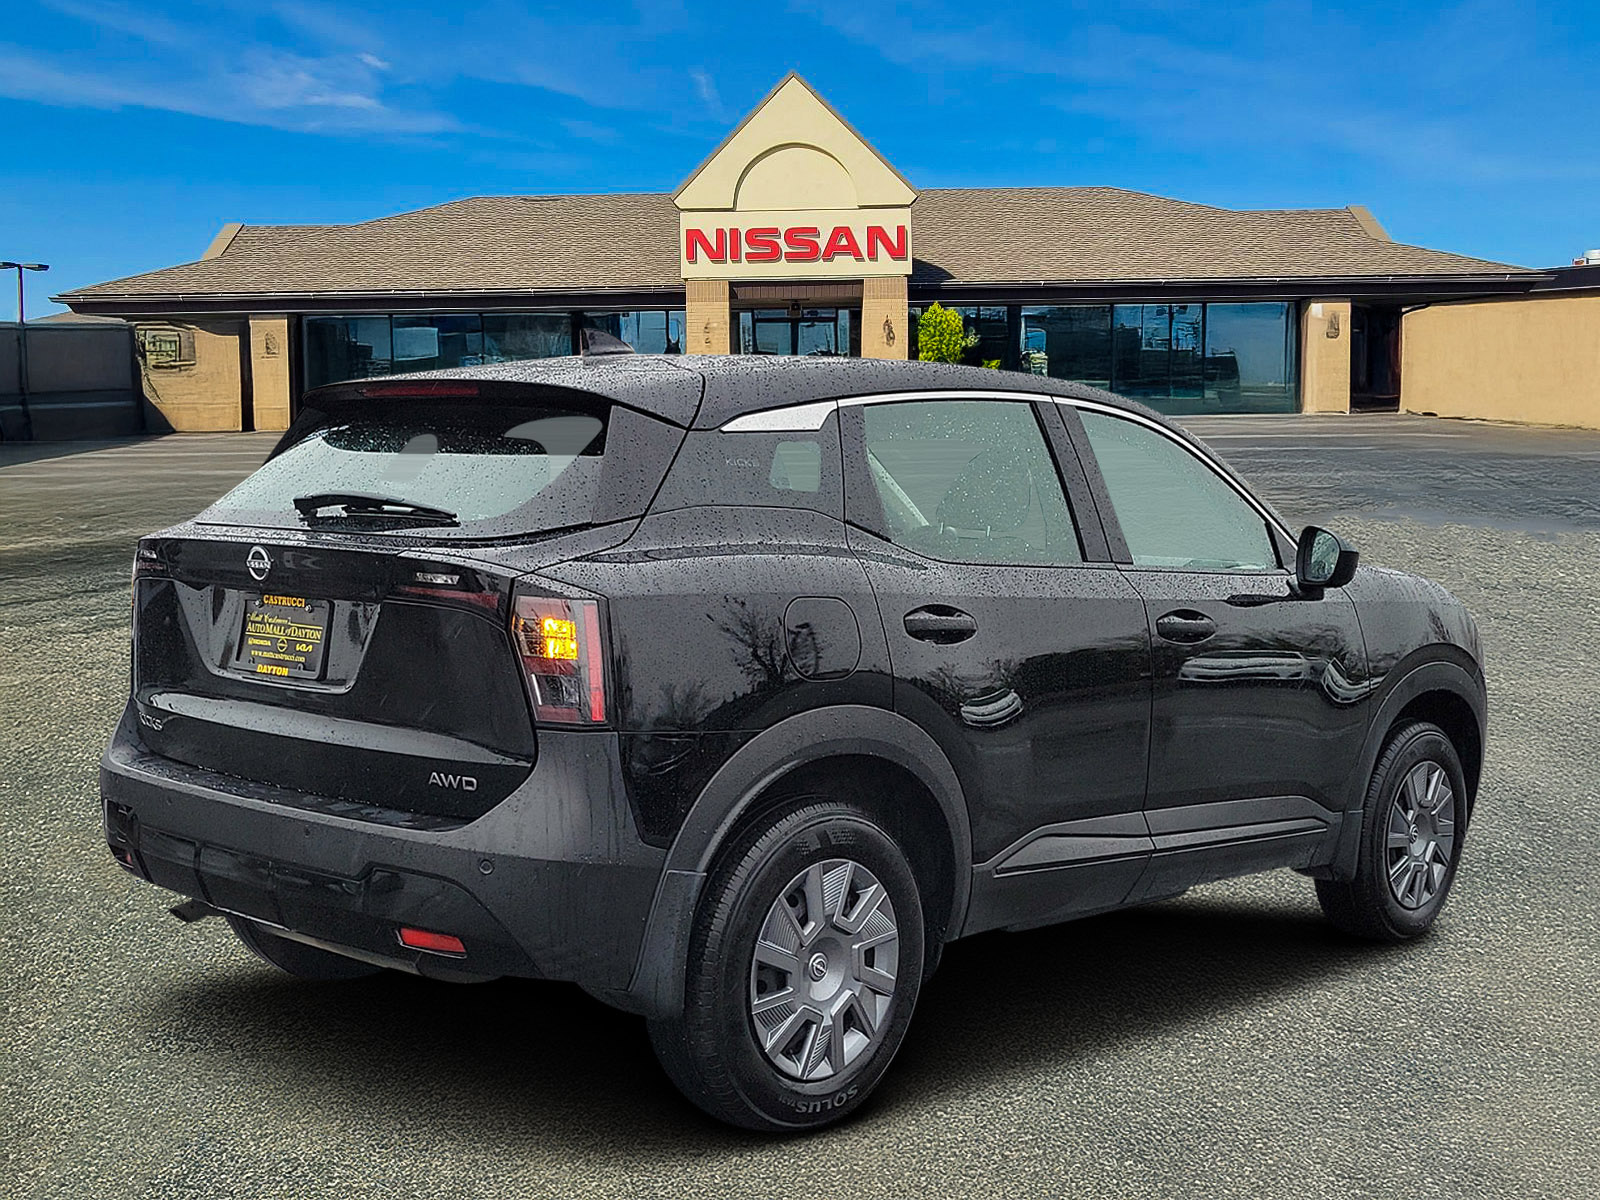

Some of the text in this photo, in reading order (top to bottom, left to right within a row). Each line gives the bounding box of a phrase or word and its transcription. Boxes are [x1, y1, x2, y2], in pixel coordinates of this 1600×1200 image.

[685, 226, 907, 264] NISSAN
[263, 595, 305, 607] CASTRUCCI
[256, 664, 288, 676] DAYTON
[429, 772, 477, 790] AWD
[795, 1084, 858, 1113] SOLUS
